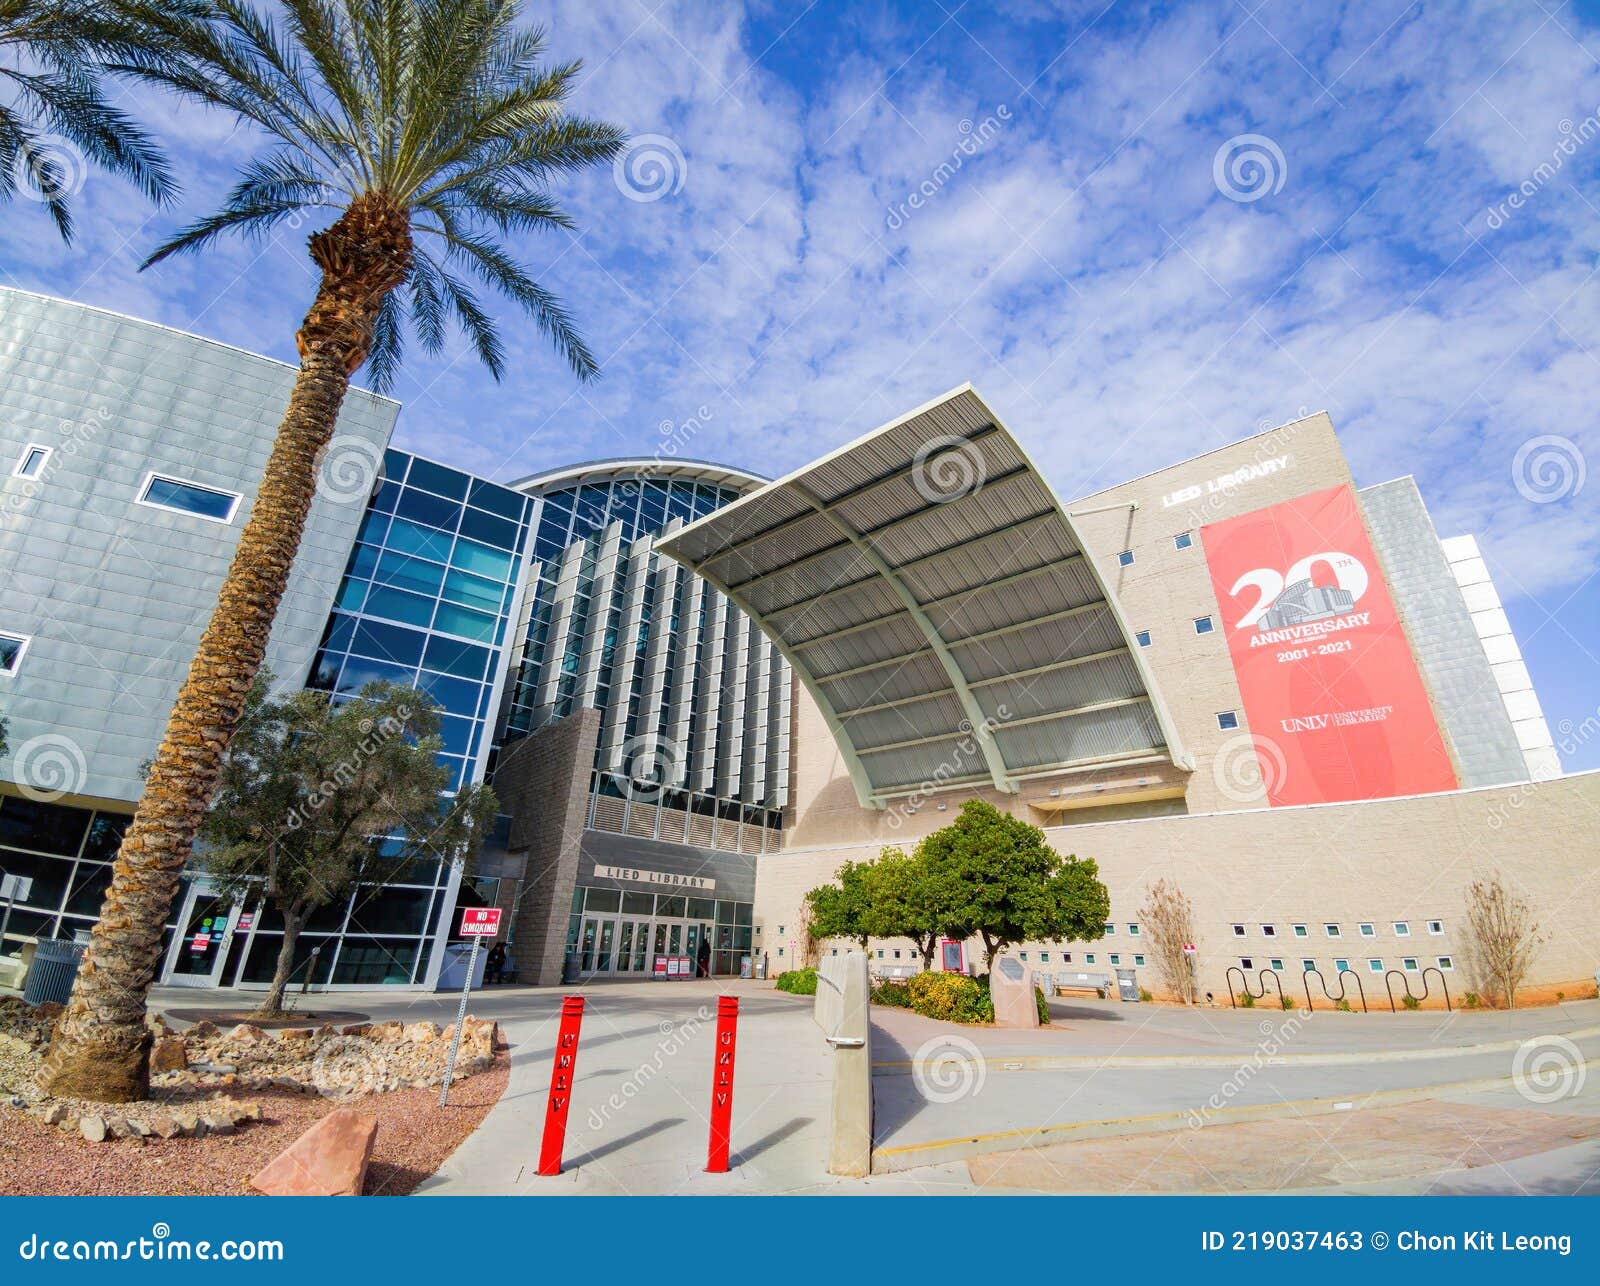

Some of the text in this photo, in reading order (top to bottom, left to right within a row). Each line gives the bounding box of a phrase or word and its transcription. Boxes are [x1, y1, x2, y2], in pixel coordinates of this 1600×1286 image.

[1229, 551, 1368, 628] 20
[1250, 612, 1371, 648] ANNIVERSARY
[1277, 647, 1309, 663] 2001
[1319, 639, 1352, 655] 2021
[1334, 705, 1393, 720] UNIVERSITY
[1280, 713, 1328, 733] UNLV
[607, 867, 705, 887] LIED LIBRARY
[477, 911, 488, 921] NO
[463, 922, 497, 933] SMOKING
[717, 1031, 733, 1107] UNLV
